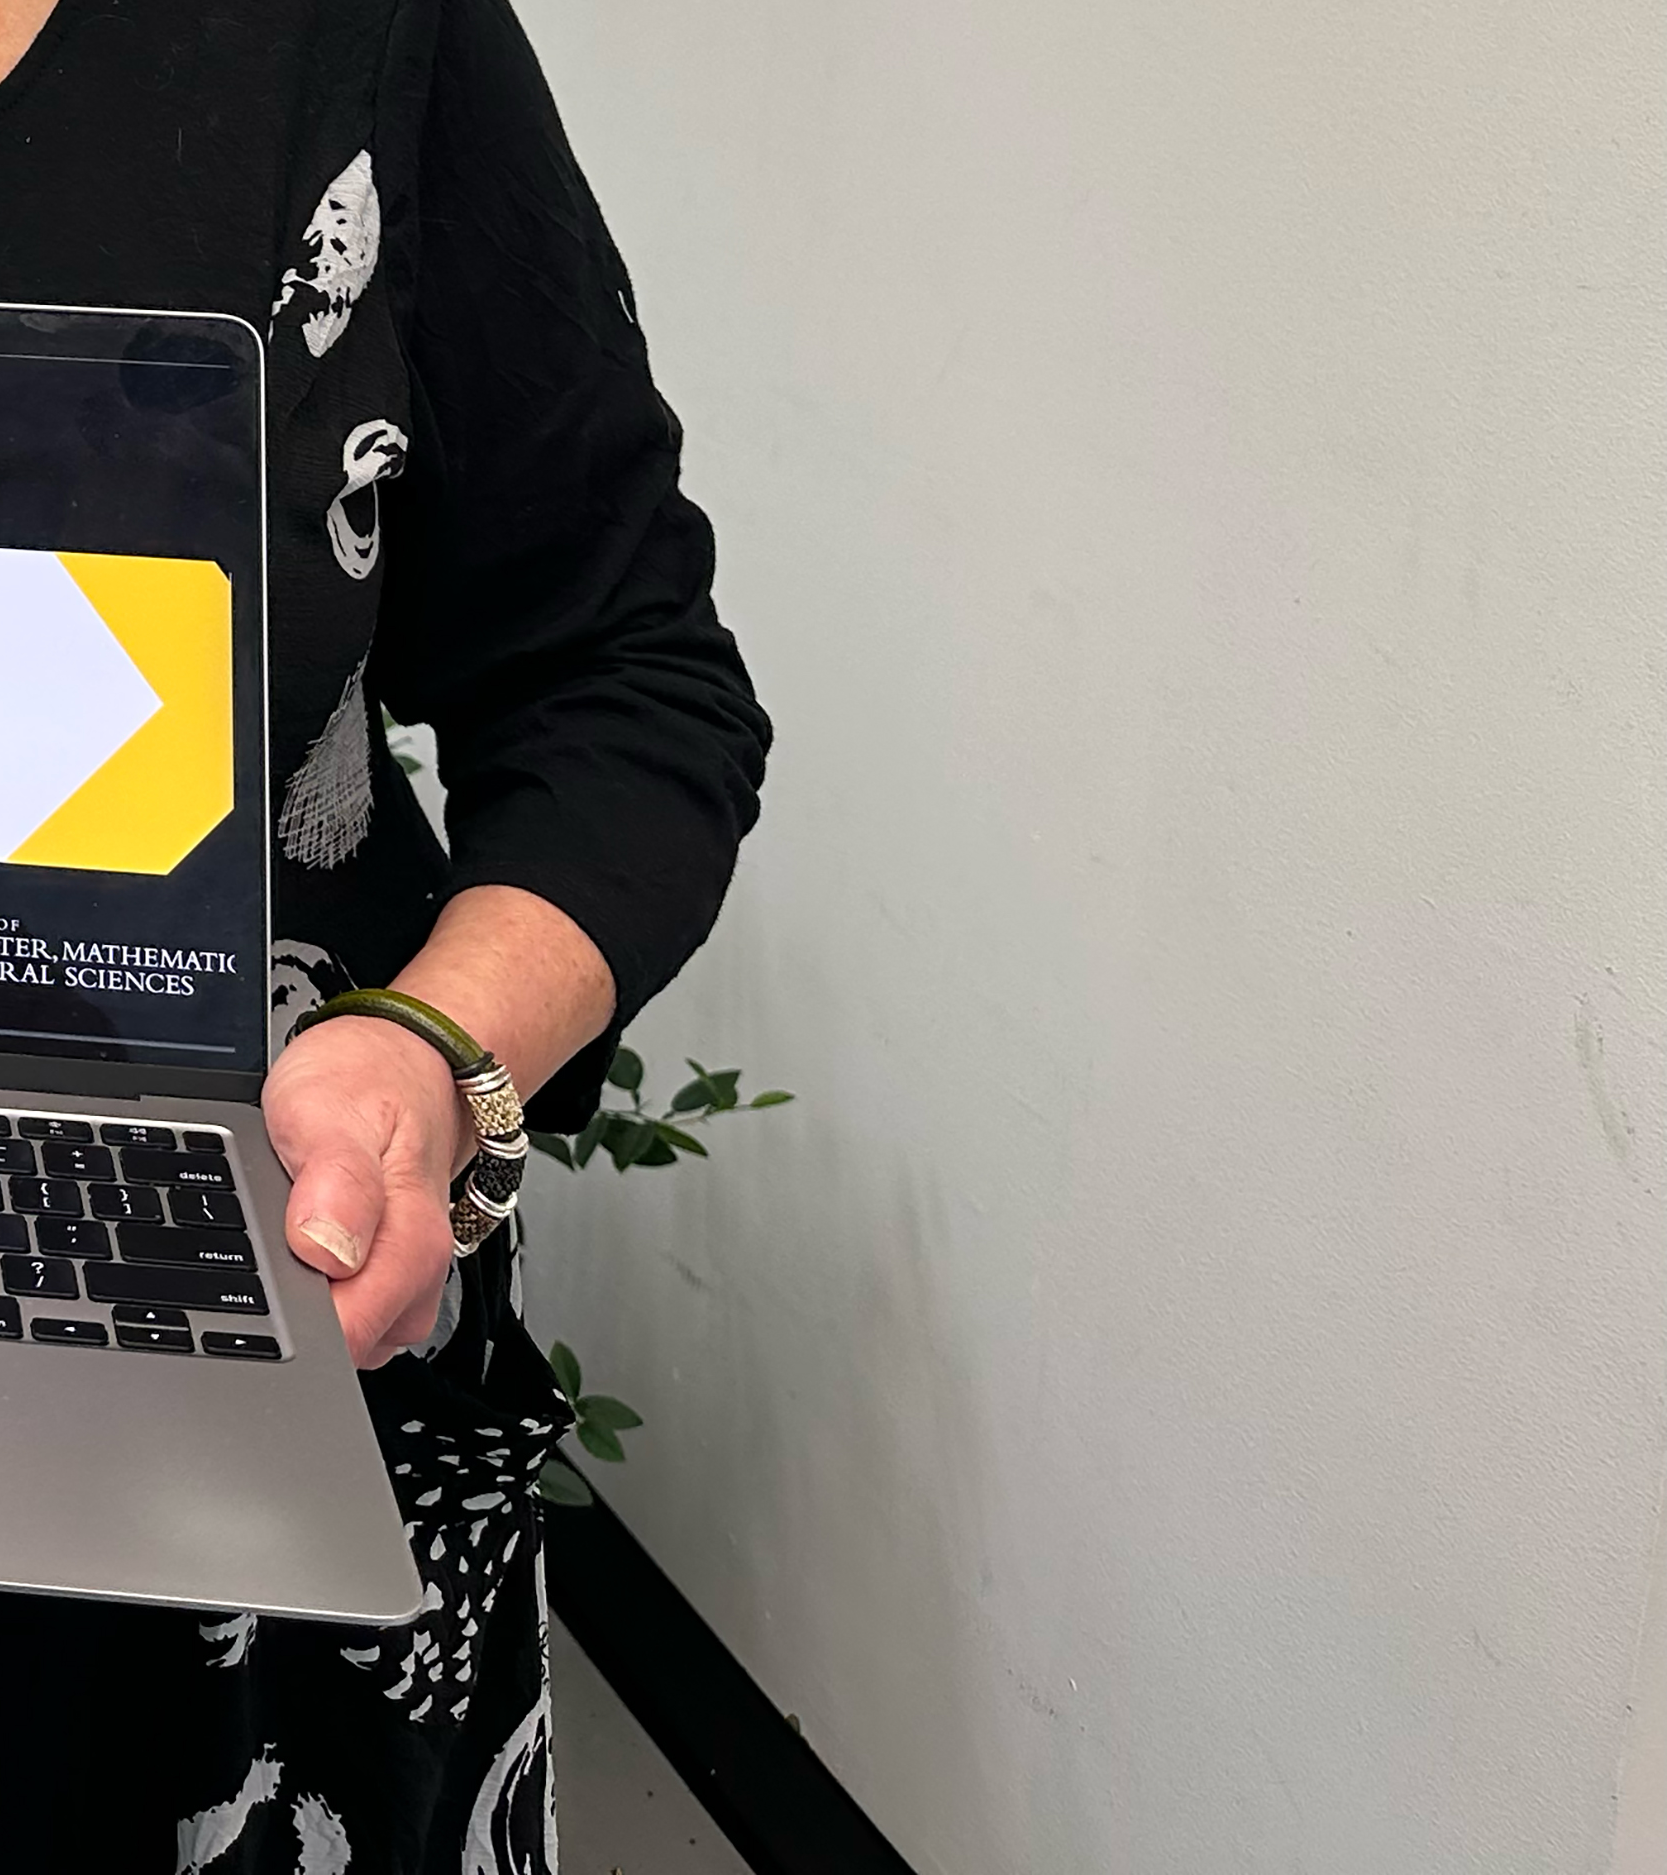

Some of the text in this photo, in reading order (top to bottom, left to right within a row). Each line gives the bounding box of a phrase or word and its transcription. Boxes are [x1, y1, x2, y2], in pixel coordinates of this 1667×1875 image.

[64, 967, 195, 996] SCIENCES
[179, 1171, 222, 1182] delete
[199, 1252, 244, 1262] return
[220, 1294, 255, 1304] shift
